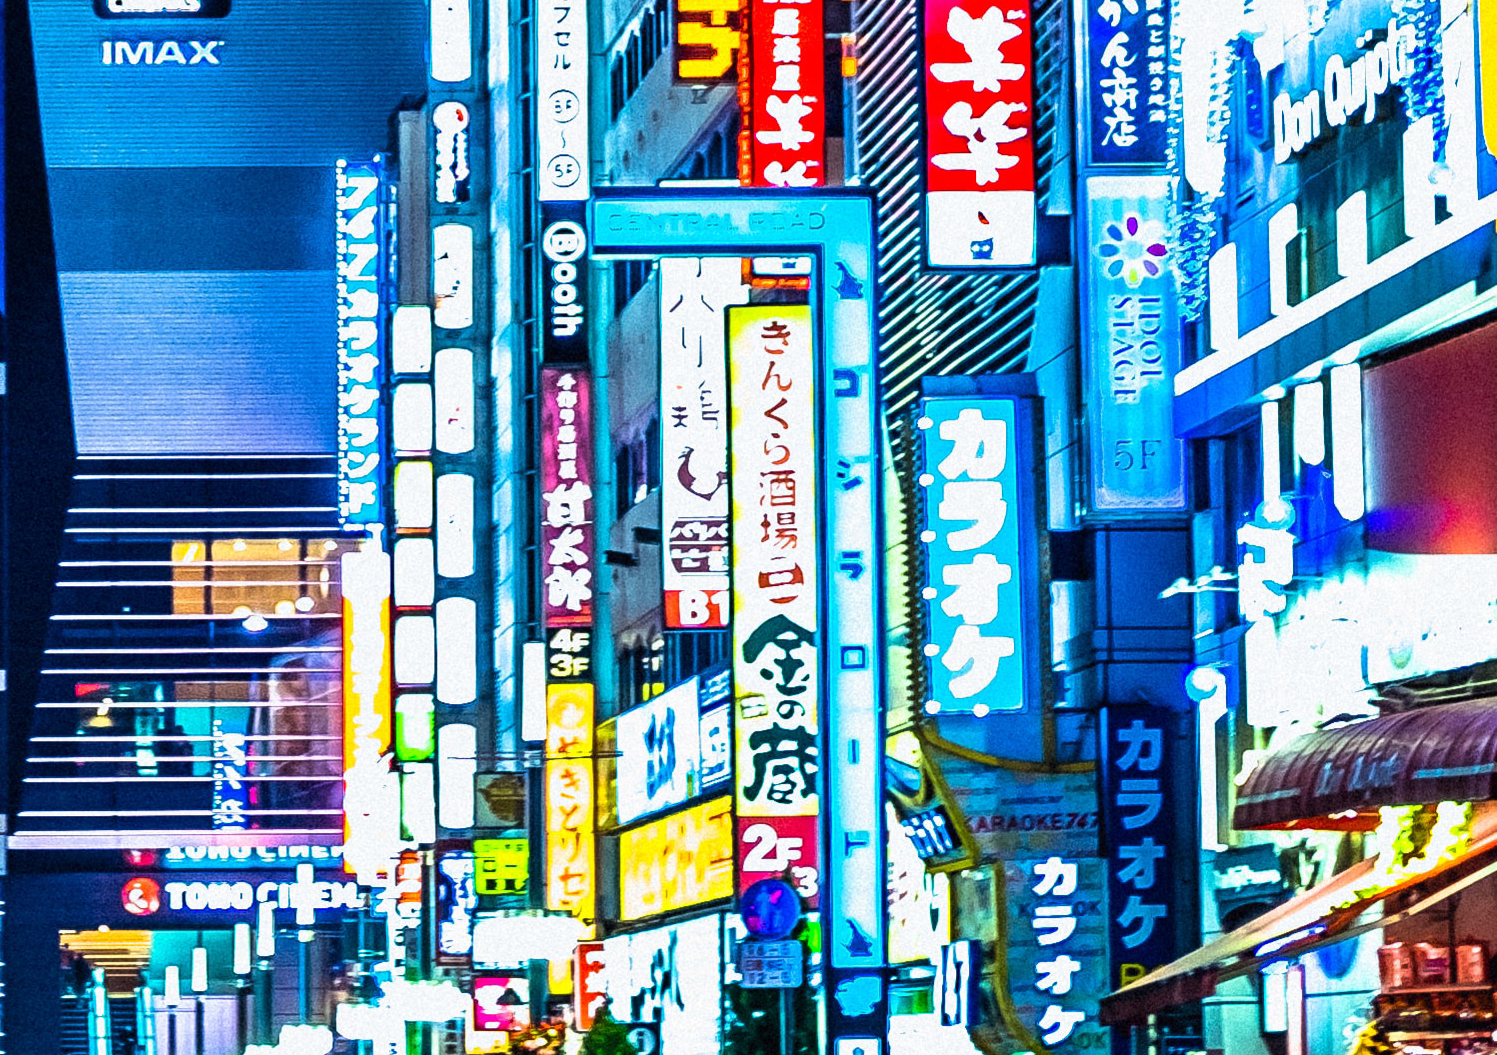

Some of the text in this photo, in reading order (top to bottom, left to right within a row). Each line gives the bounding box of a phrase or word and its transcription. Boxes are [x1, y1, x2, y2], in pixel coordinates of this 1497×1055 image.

[101, 41, 220, 65] IMAX
[1274, 18, 1414, 164] Don Quijot
[752, 212, 826, 230] ROAD
[542, 220, 587, 336] Booth
[1112, 295, 1140, 404] STAGE
[1138, 298, 1163, 377] IDOL
[759, 321, 796, 550] きんくら酒場
[1114, 440, 1161, 471] 5F
[542, 481, 592, 611] 甘太郎
[938, 409, 1014, 698] カラオケ
[550, 629, 590, 653] 4F
[679, 590, 729, 626] B1
[550, 655, 589, 676] 3F
[743, 614, 818, 803] 金の蔵
[742, 823, 802, 872] 2F
[1117, 720, 1167, 949] カラオケ
[165, 882, 253, 910] TOHO
[1032, 857, 1085, 1045] カラオケ
